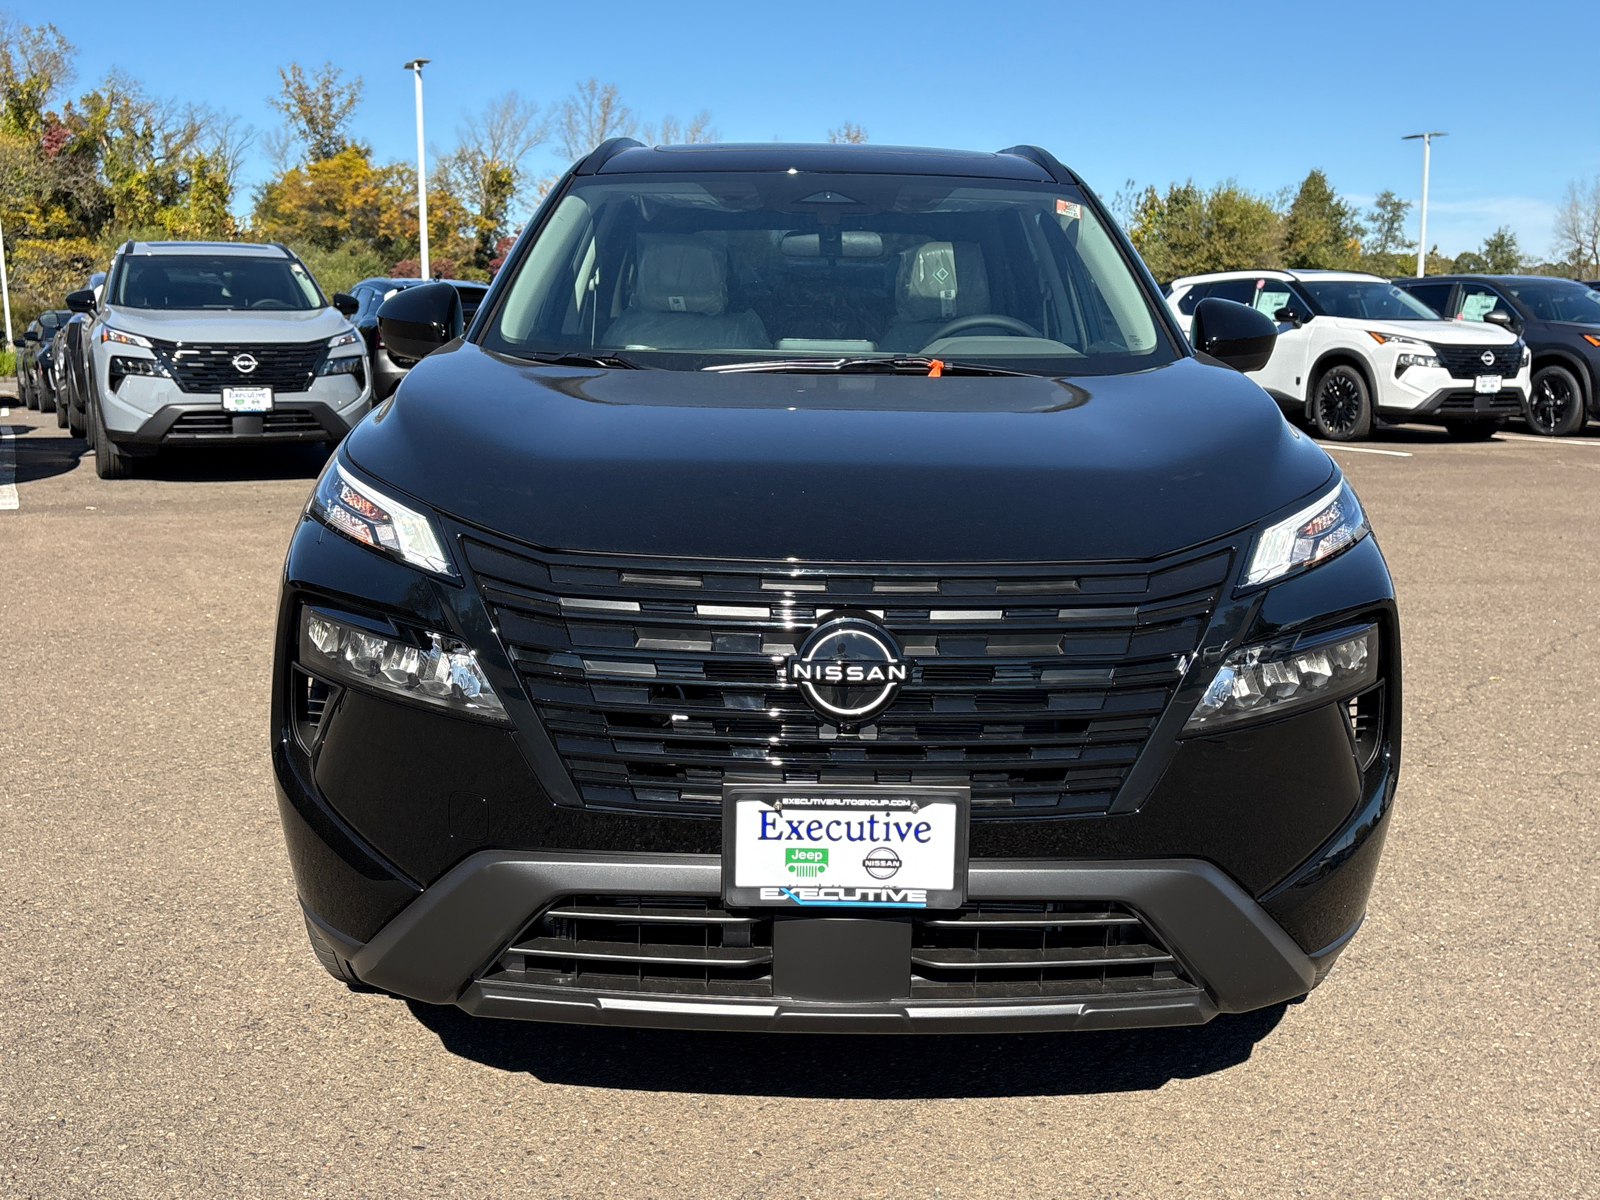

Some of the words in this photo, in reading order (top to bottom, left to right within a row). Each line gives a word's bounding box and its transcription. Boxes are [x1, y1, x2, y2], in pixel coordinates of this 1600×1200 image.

[793, 664, 906, 680] NISSAN
[782, 798, 911, 807] EXECUTIVEAUTOGROUP.COM
[757, 809, 932, 843] Executive
[791, 849, 823, 862] Jeep
[760, 887, 927, 903] EXECUTIVE
